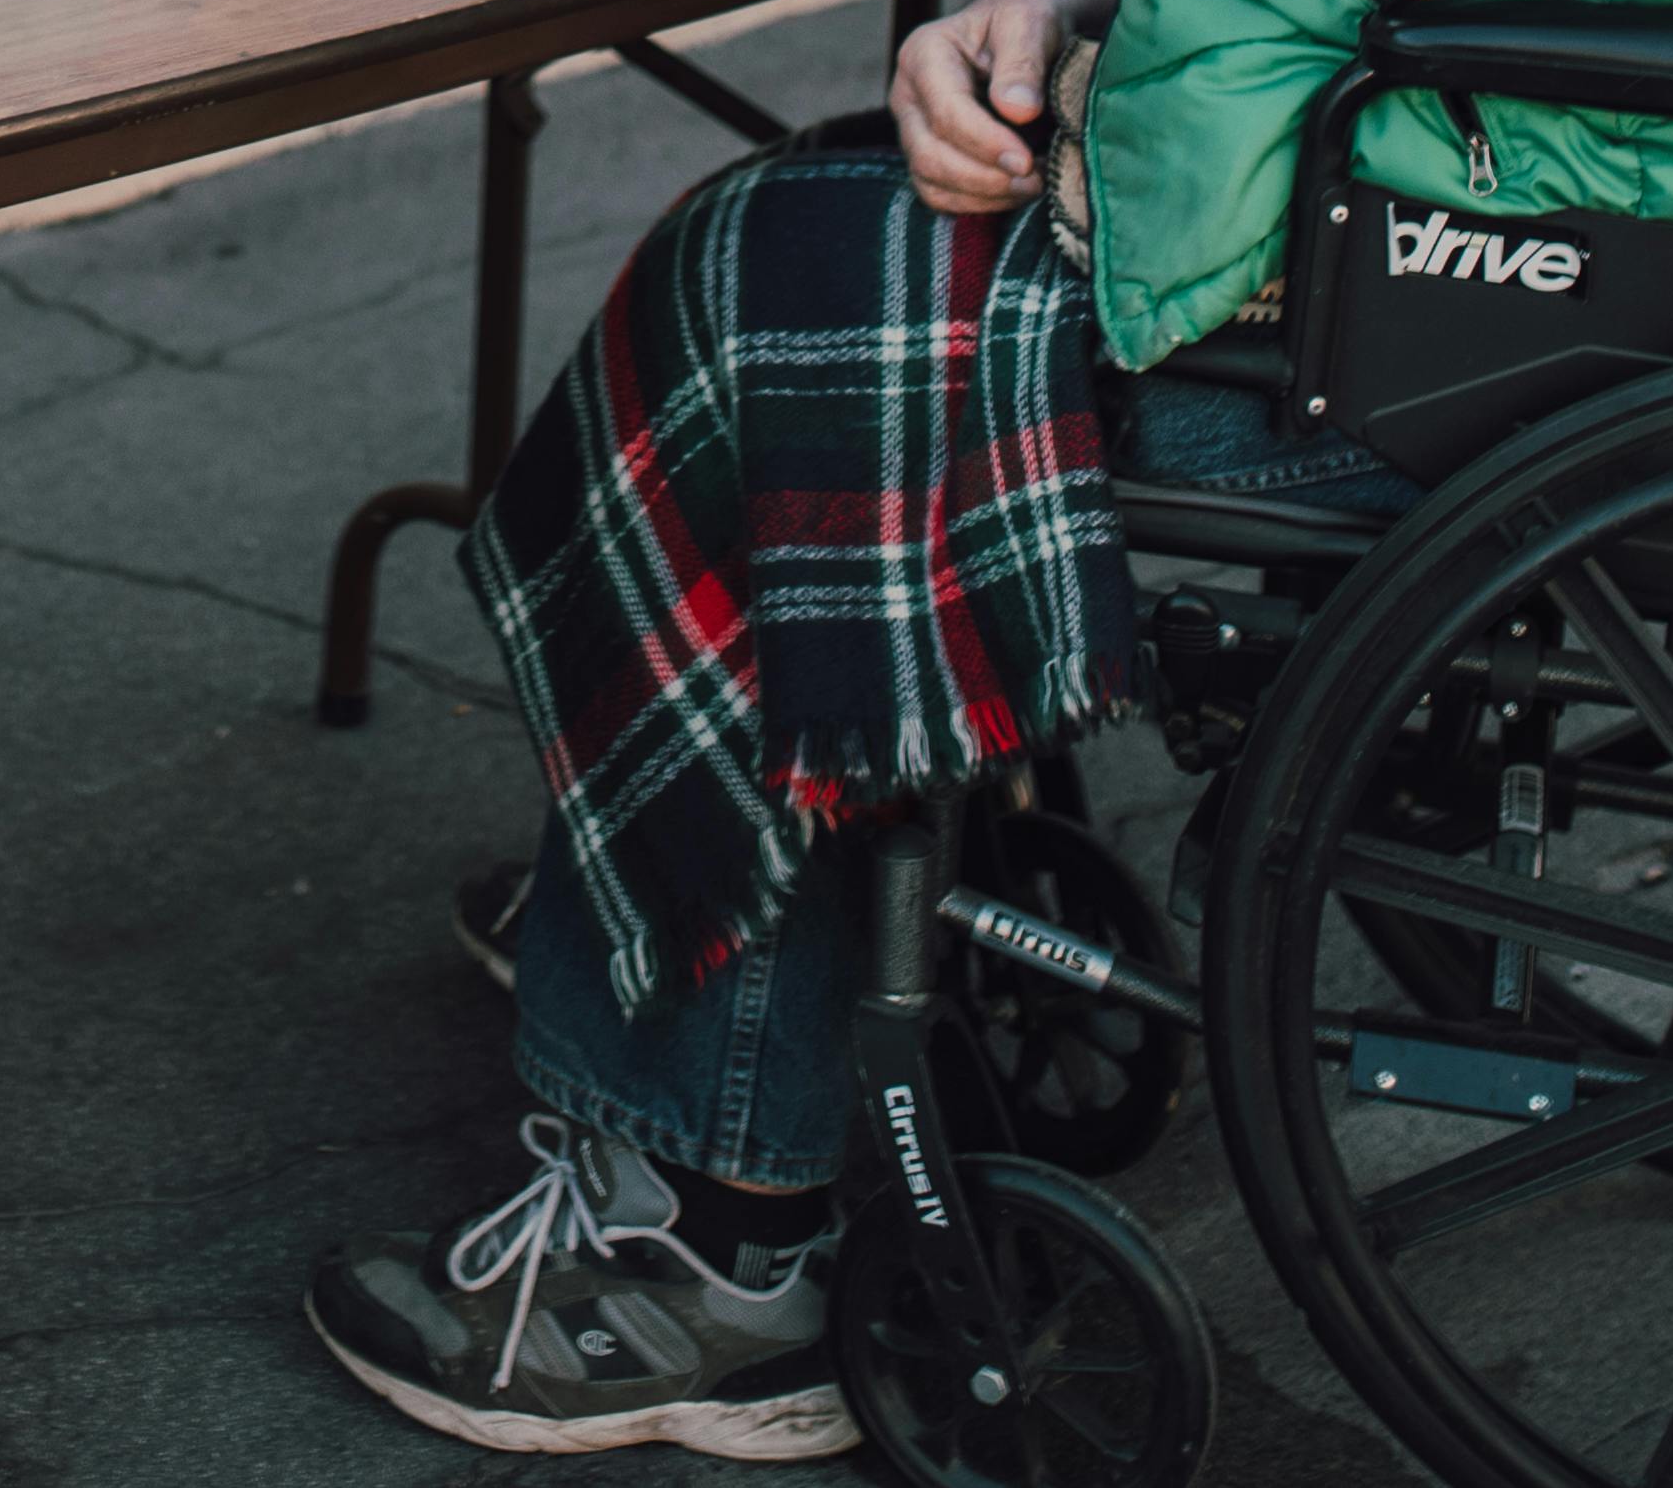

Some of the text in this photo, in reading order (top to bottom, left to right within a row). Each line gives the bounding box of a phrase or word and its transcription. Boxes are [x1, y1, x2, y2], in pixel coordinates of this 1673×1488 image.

[1386, 201, 1582, 292] drive
[990, 910, 1093, 974] Cirrus
[883, 1085, 950, 1228] Cirrus IV
